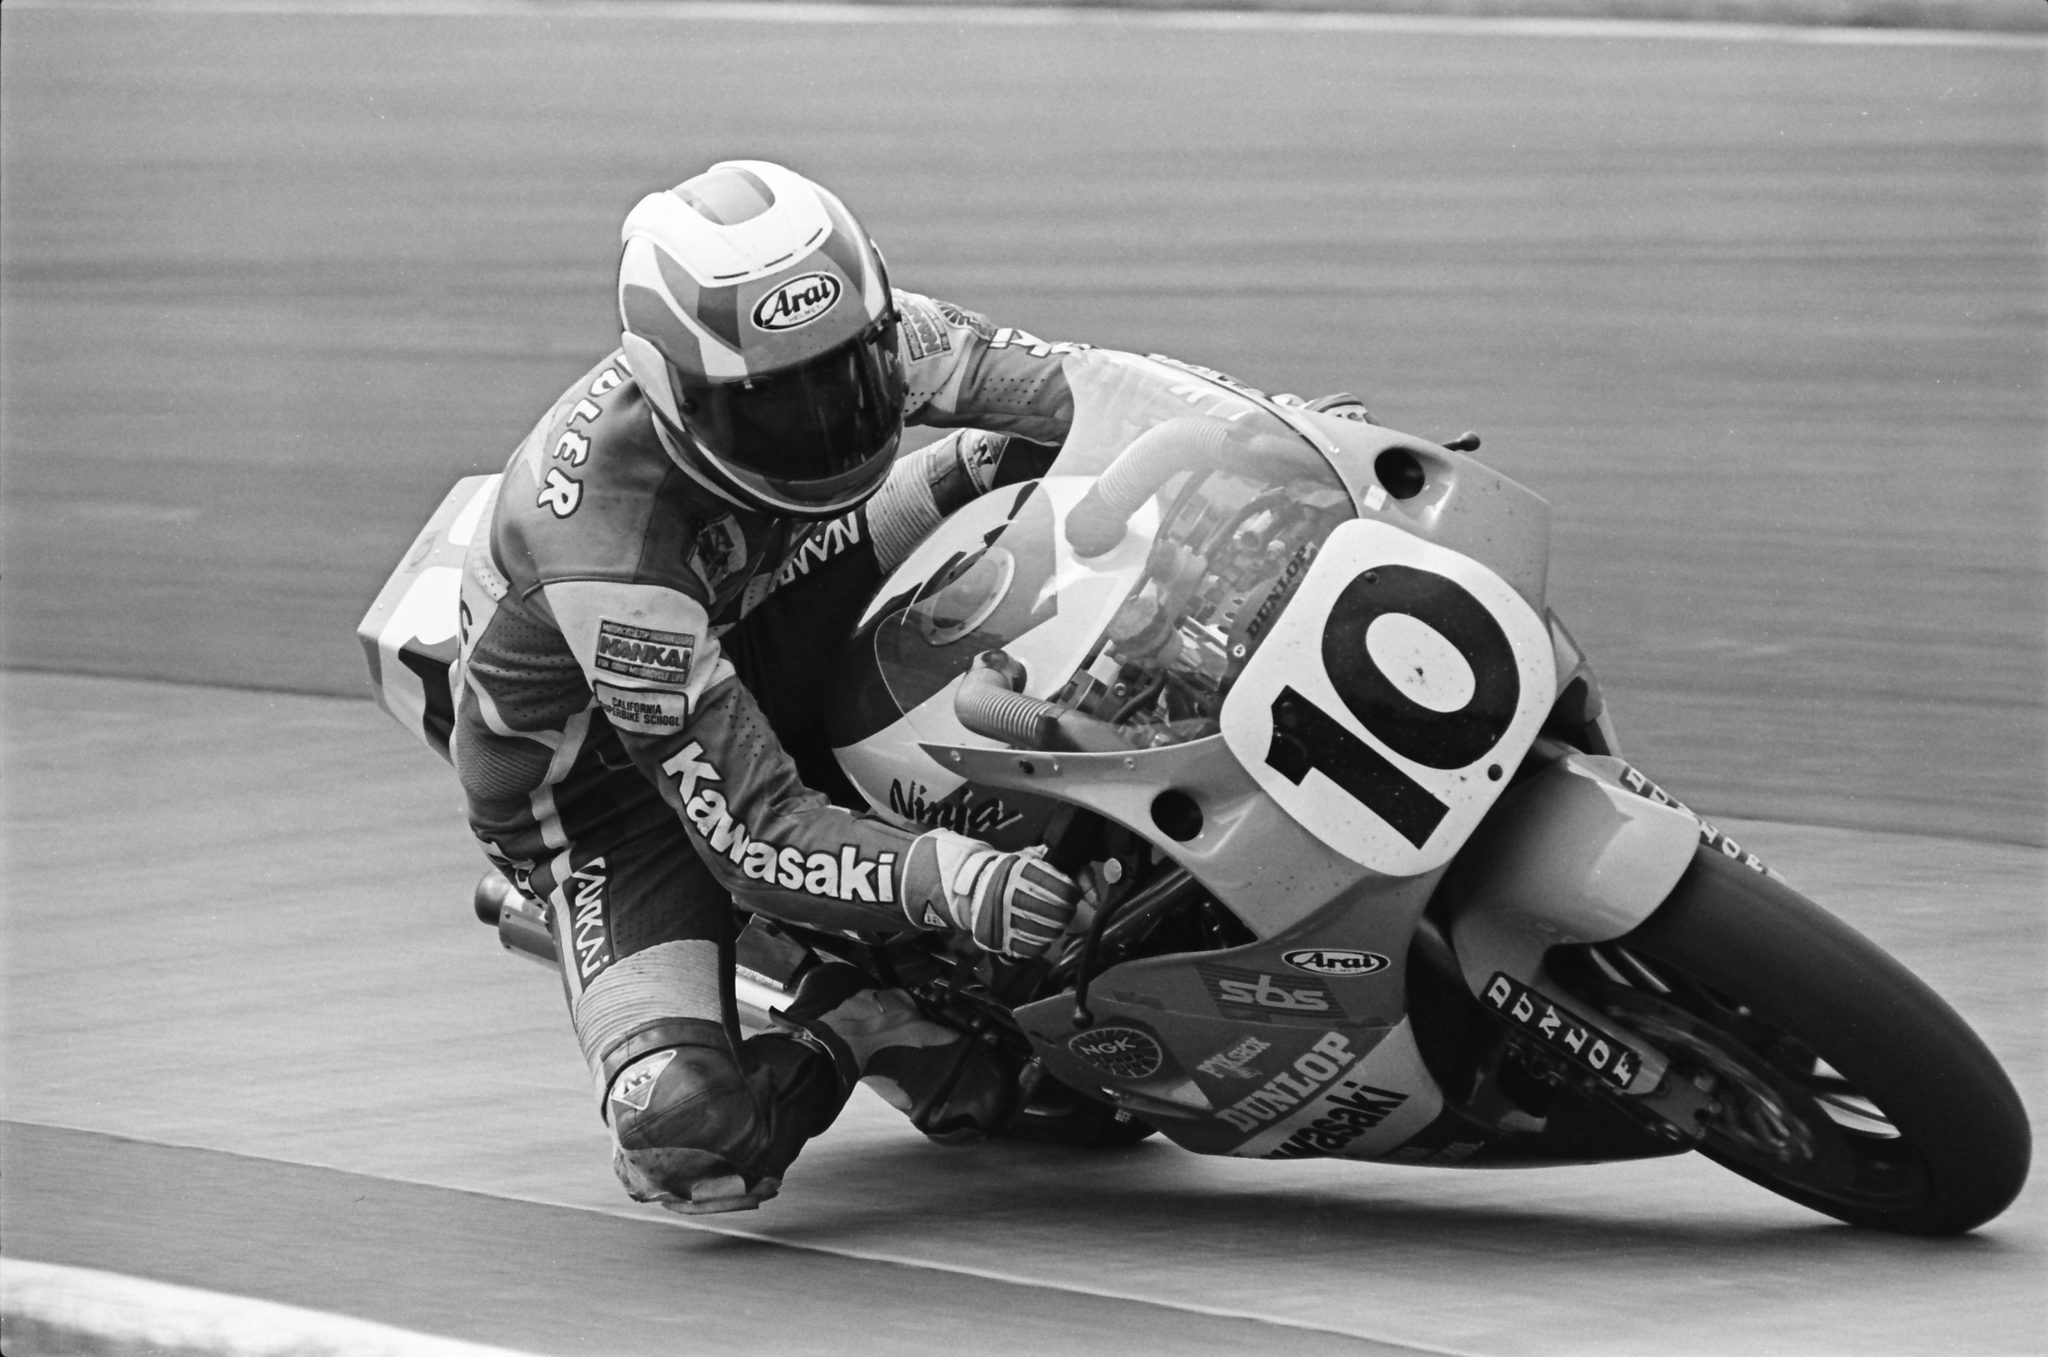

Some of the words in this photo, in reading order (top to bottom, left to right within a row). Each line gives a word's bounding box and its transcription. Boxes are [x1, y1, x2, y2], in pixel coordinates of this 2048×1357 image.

[763, 275, 831, 326] Arai
[1246, 545, 1306, 640] DUNLOP
[598, 635, 691, 670] NANKAI
[612, 697, 662, 715] CALIFORNIA
[643, 714, 681, 727] SCHOOL
[1264, 564, 1521, 850] 10
[661, 740, 894, 903] Kawasaki
[890, 778, 1023, 836] Ninja
[1293, 952, 1376, 969] Arai
[1218, 974, 1329, 1011] sbs
[1080, 1036, 1137, 1055] NGK
[1214, 1031, 1356, 1133] DUNLOP
